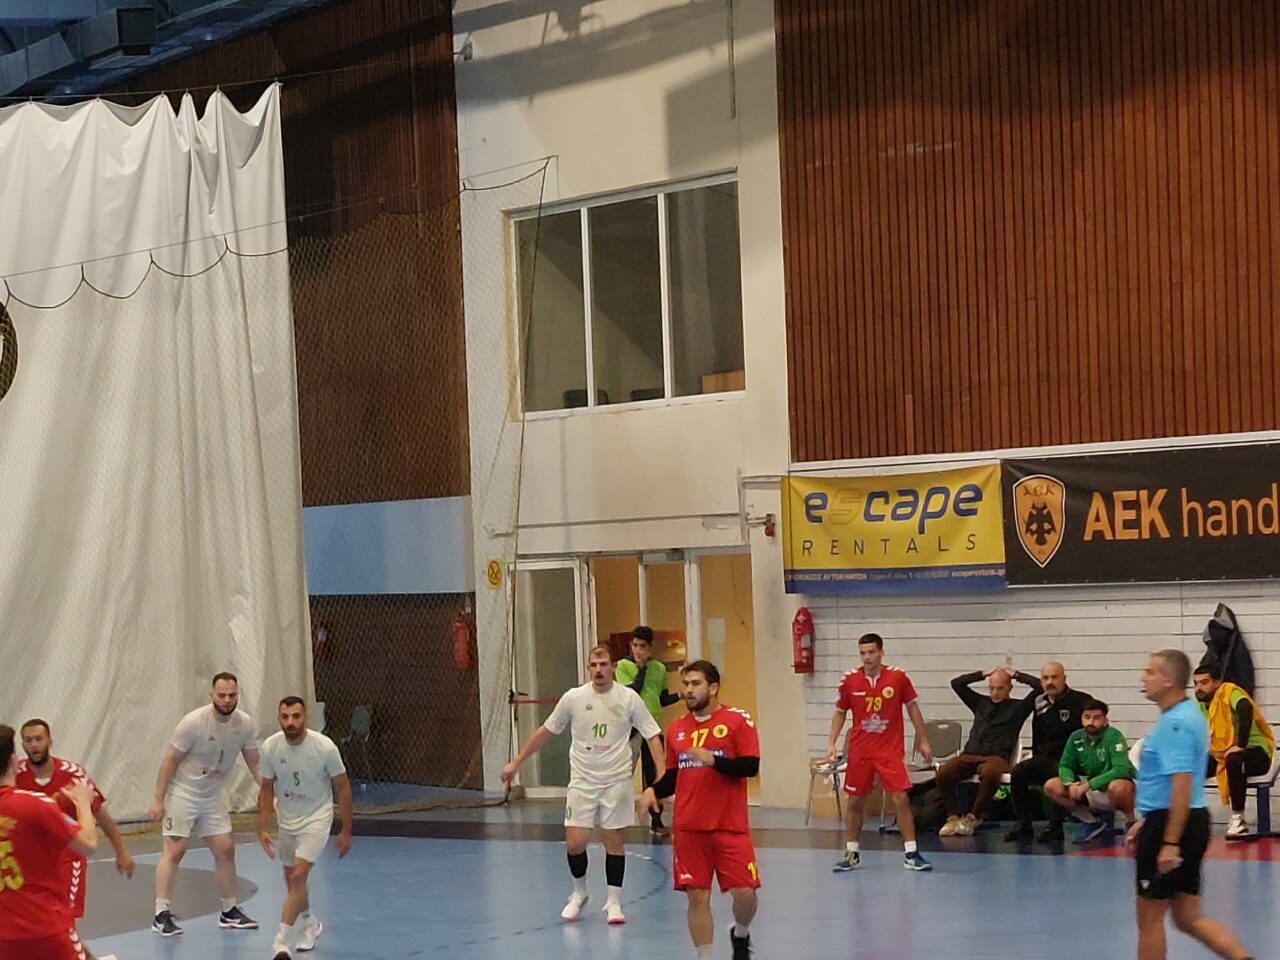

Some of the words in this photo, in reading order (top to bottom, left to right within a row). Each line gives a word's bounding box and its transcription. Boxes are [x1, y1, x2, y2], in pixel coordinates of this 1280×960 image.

[804, 483, 983, 535] escape
[1083, 488, 1171, 541] AEK
[1181, 482, 1280, 538] hand
[802, 534, 976, 556] RENTALS
[592, 723, 608, 738] 10
[691, 728, 709, 748] 17
